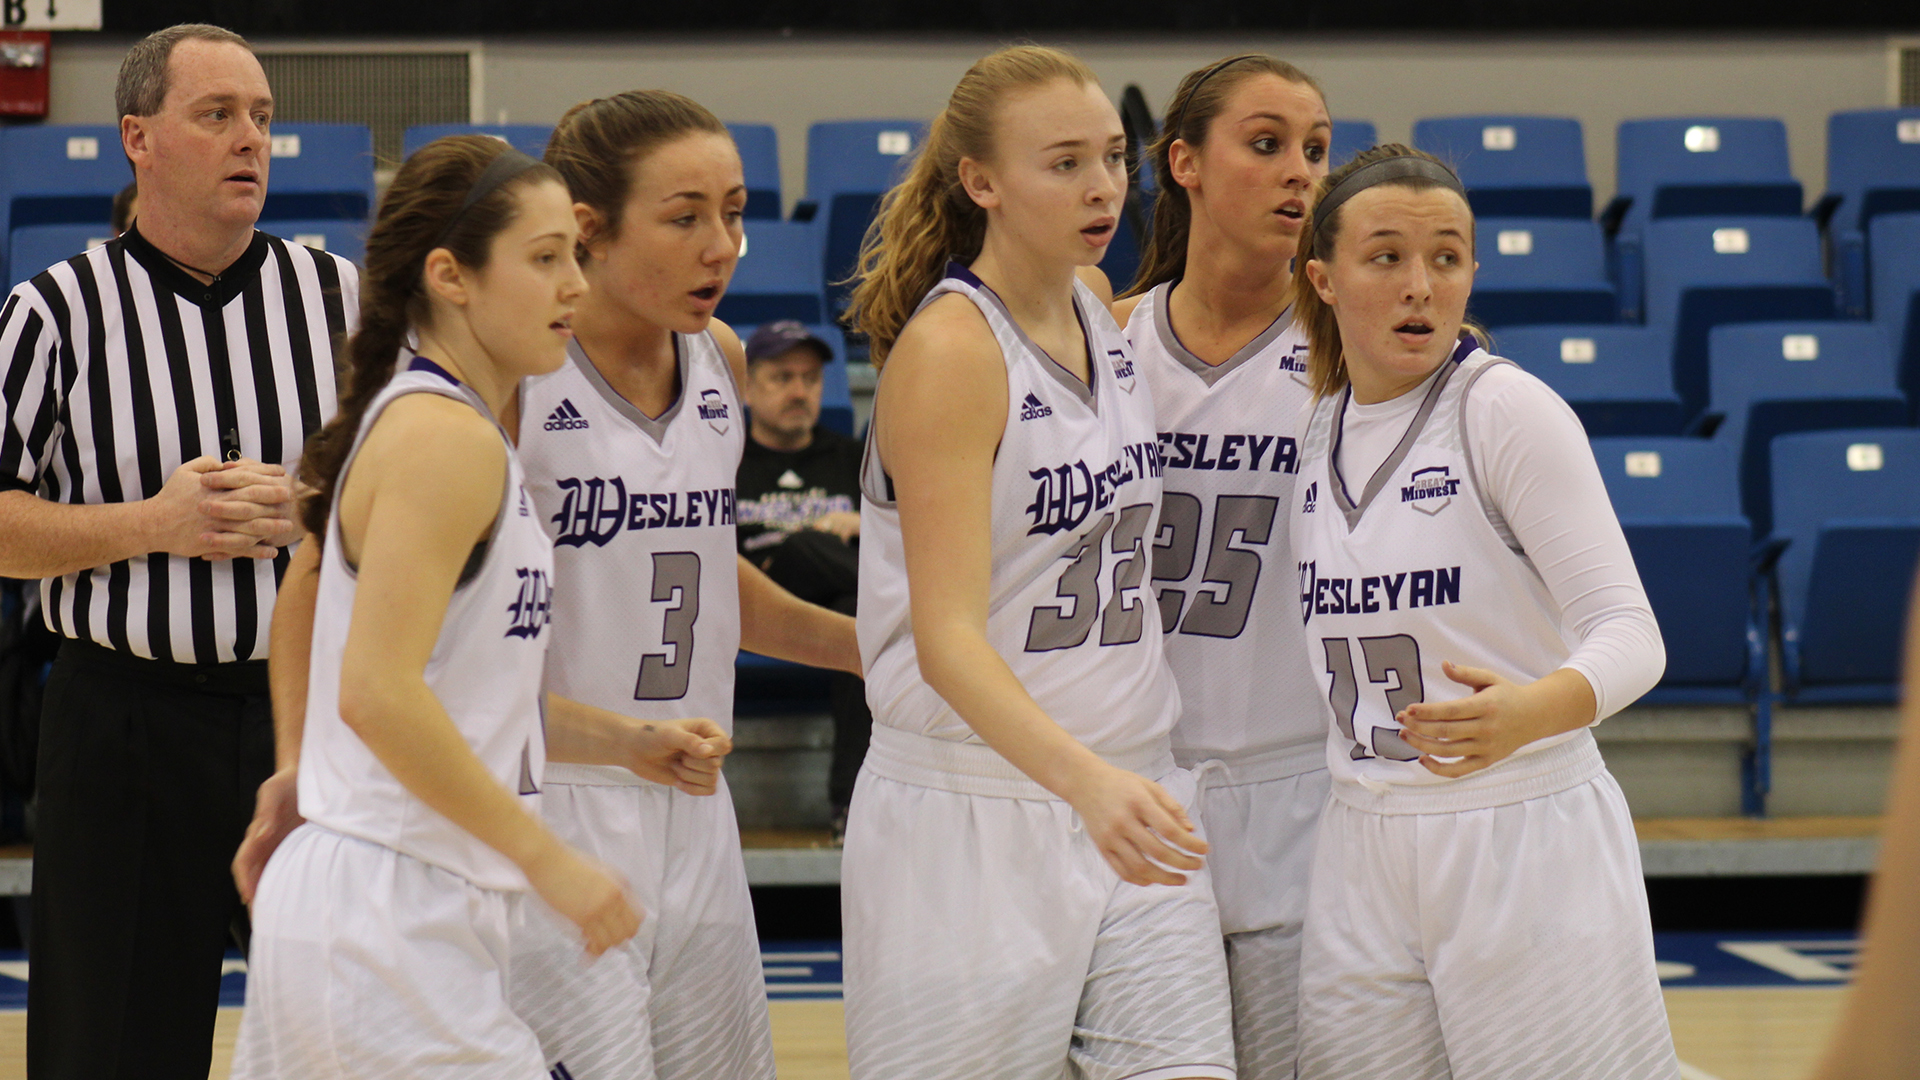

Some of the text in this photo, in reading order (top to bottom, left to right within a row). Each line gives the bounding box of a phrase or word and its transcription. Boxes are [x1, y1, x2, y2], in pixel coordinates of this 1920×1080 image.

[543, 417, 589, 431] adidas
[1156, 432, 1301, 474] ESLEYA
[1401, 478, 1460, 502] MIDWEST
[1414, 476, 1446, 489] GREAT
[1024, 502, 1154, 652] 32
[1151, 491, 1280, 639] 25
[634, 551, 701, 700] 3
[1321, 633, 1425, 762] 13
